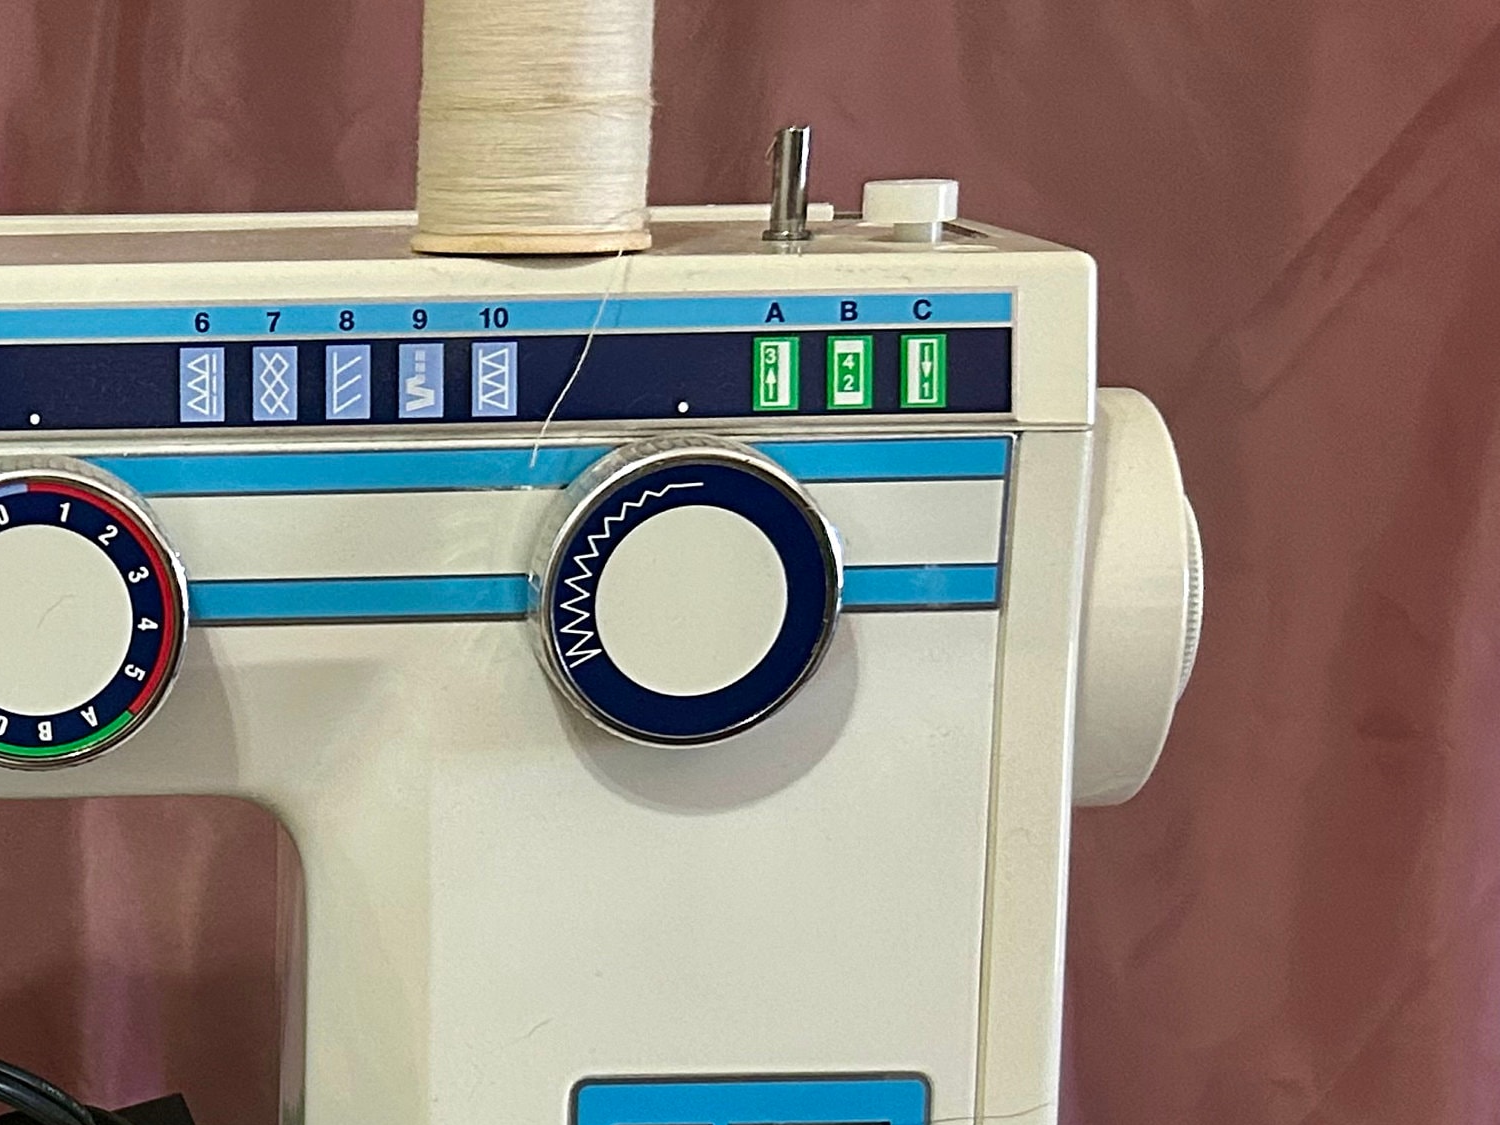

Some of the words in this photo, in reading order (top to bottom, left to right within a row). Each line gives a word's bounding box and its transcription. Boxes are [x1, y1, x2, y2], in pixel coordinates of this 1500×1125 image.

[194, 311, 210, 333] 6
[266, 311, 282, 333] 7
[339, 310, 355, 331] 8
[412, 309, 428, 330] 9
[478, 307, 509, 328] 10
[764, 302, 785, 323] A
[840, 300, 858, 321] B
[913, 299, 932, 320] C
[764, 348, 777, 364] 3
[841, 353, 855, 369] 4
[843, 374, 854, 391] 2
[921, 381, 931, 397] 1
[59, 501, 71, 522] 1
[97, 524, 118, 547] 2
[127, 565, 149, 583] 3
[137, 617, 159, 631] 4
[124, 663, 146, 682] 5
[80, 705, 99, 727] A
[37, 721, 53, 742] B
